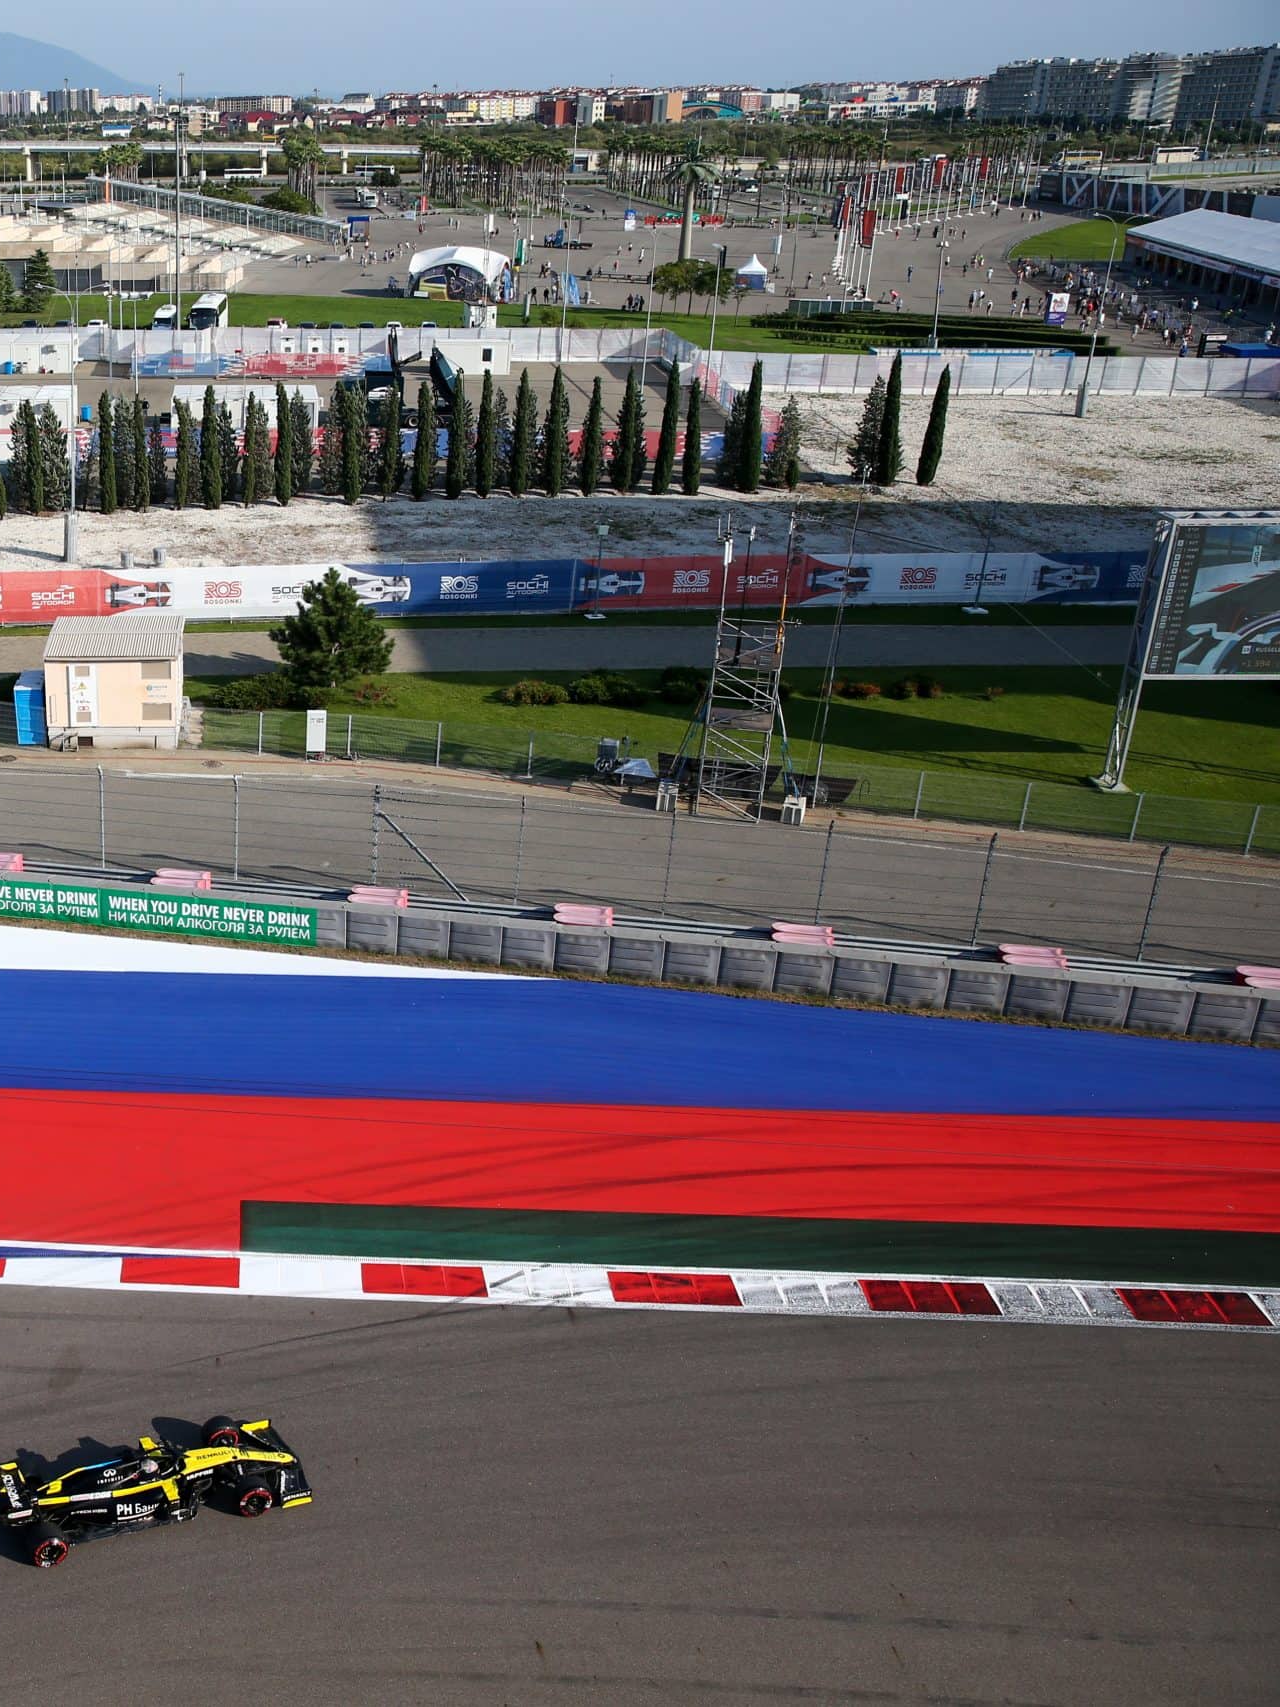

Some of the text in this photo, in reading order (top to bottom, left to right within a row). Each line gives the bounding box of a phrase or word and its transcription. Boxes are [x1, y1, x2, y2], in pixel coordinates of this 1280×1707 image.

[673, 570, 711, 587] ROS
[737, 575, 778, 585] SOCHI
[900, 568, 937, 583] ROS
[965, 573, 1006, 582] SOCHI
[204, 581, 242, 597] ROS
[440, 576, 478, 592] ROS
[506, 581, 549, 590] SOCHI
[31, 592, 75, 601] SOCHI
[15, 887, 53, 902] NEVER
[57, 891, 96, 905] DRINK
[39, 903, 54, 913] ЗА
[57, 904, 98, 917] РУЛЕМ
[108, 896, 309, 926] WHEN YOU DRIVE NEVER DRINK
[108, 910, 310, 939] НИ КАПЛИ АЛКОГОЛЯ ЗА РУЛЕМ
